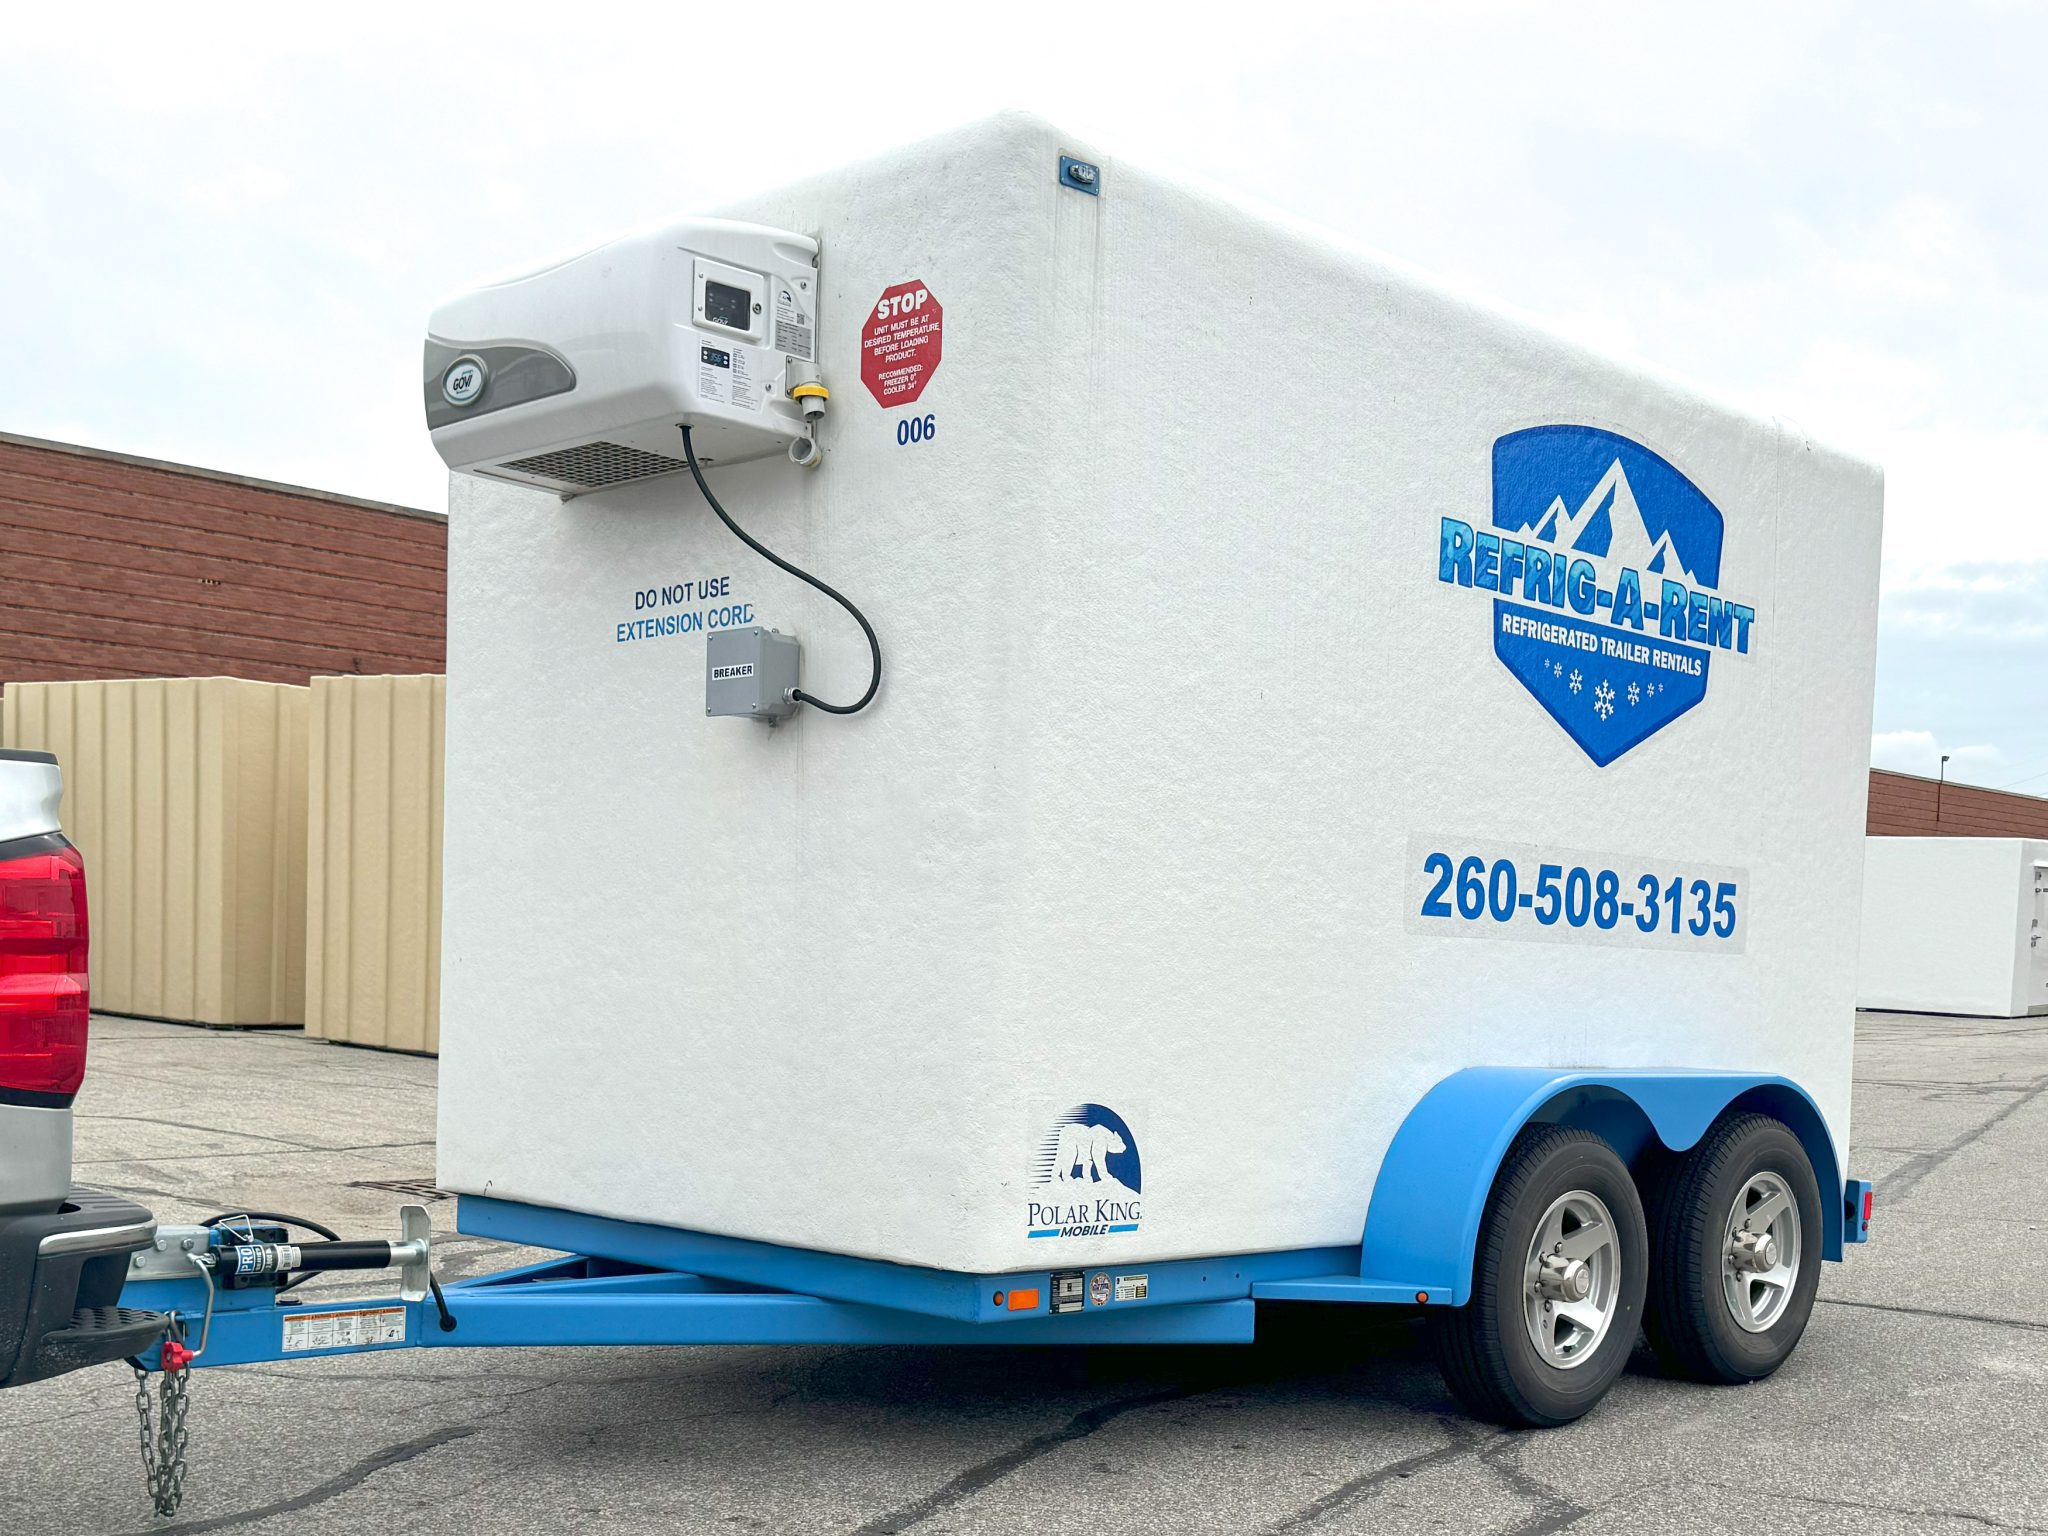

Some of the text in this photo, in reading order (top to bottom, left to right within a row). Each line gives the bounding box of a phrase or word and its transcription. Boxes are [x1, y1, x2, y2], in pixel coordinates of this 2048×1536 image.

[877, 289, 928, 320] STOP
[864, 321, 940, 348] DESIRED TEMPERATURE
[874, 314, 930, 336] UNIT MUST BE AT
[874, 335, 929, 356] BEFORE LOADING
[885, 348, 917, 363] PRODUCT.
[878, 364, 923, 381] RECOMMENDED:
[883, 375, 909, 387] FREEZER
[883, 384, 906, 396] COOLER
[897, 413, 936, 446] 006
[635, 576, 730, 610] DO NOT USE
[1439, 516, 1755, 655] REFRIG-A-RENT
[616, 603, 755, 642] EXTENSION CORD
[1502, 613, 1702, 677] REFRIGERATED TRAILER RENTALS
[713, 665, 753, 679] BREAKER
[1420, 852, 1737, 938] 260-508-3135
[1026, 1198, 1141, 1227] POLAR KING
[1060, 1224, 1109, 1238] MOBILE
[240, 1247, 254, 1272] PRO
